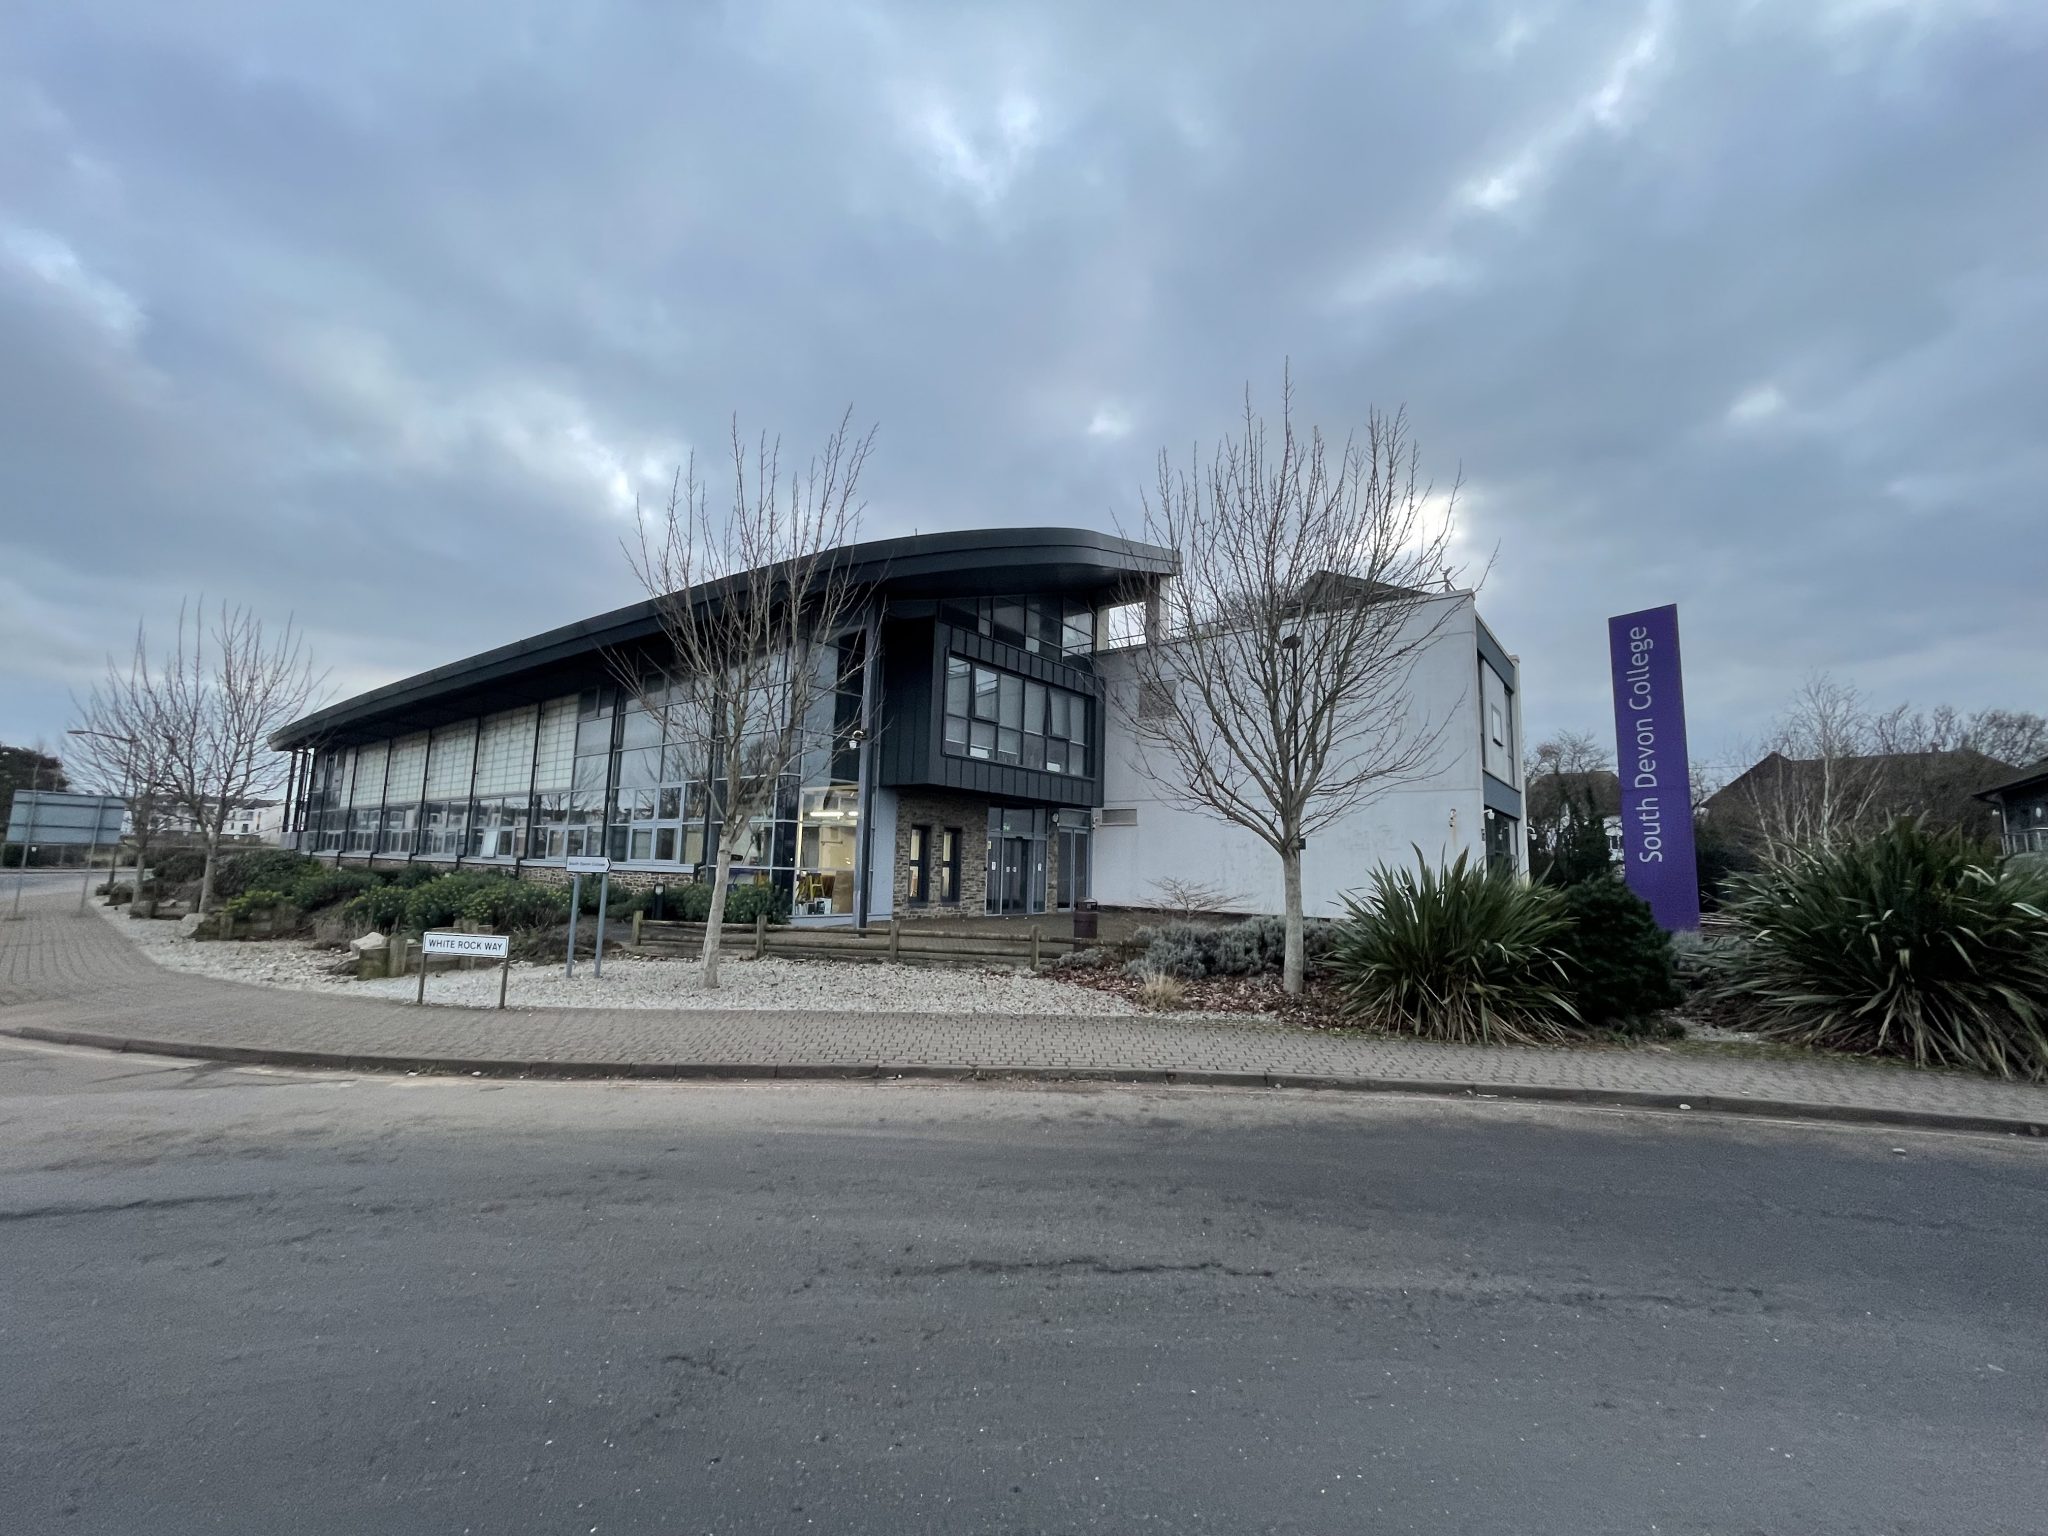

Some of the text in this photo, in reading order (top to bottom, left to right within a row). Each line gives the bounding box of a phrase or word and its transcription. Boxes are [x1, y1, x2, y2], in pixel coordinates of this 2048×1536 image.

[1627, 626, 1663, 863] South Devon College
[428, 939, 503, 951] WHITE ROCK WAY
